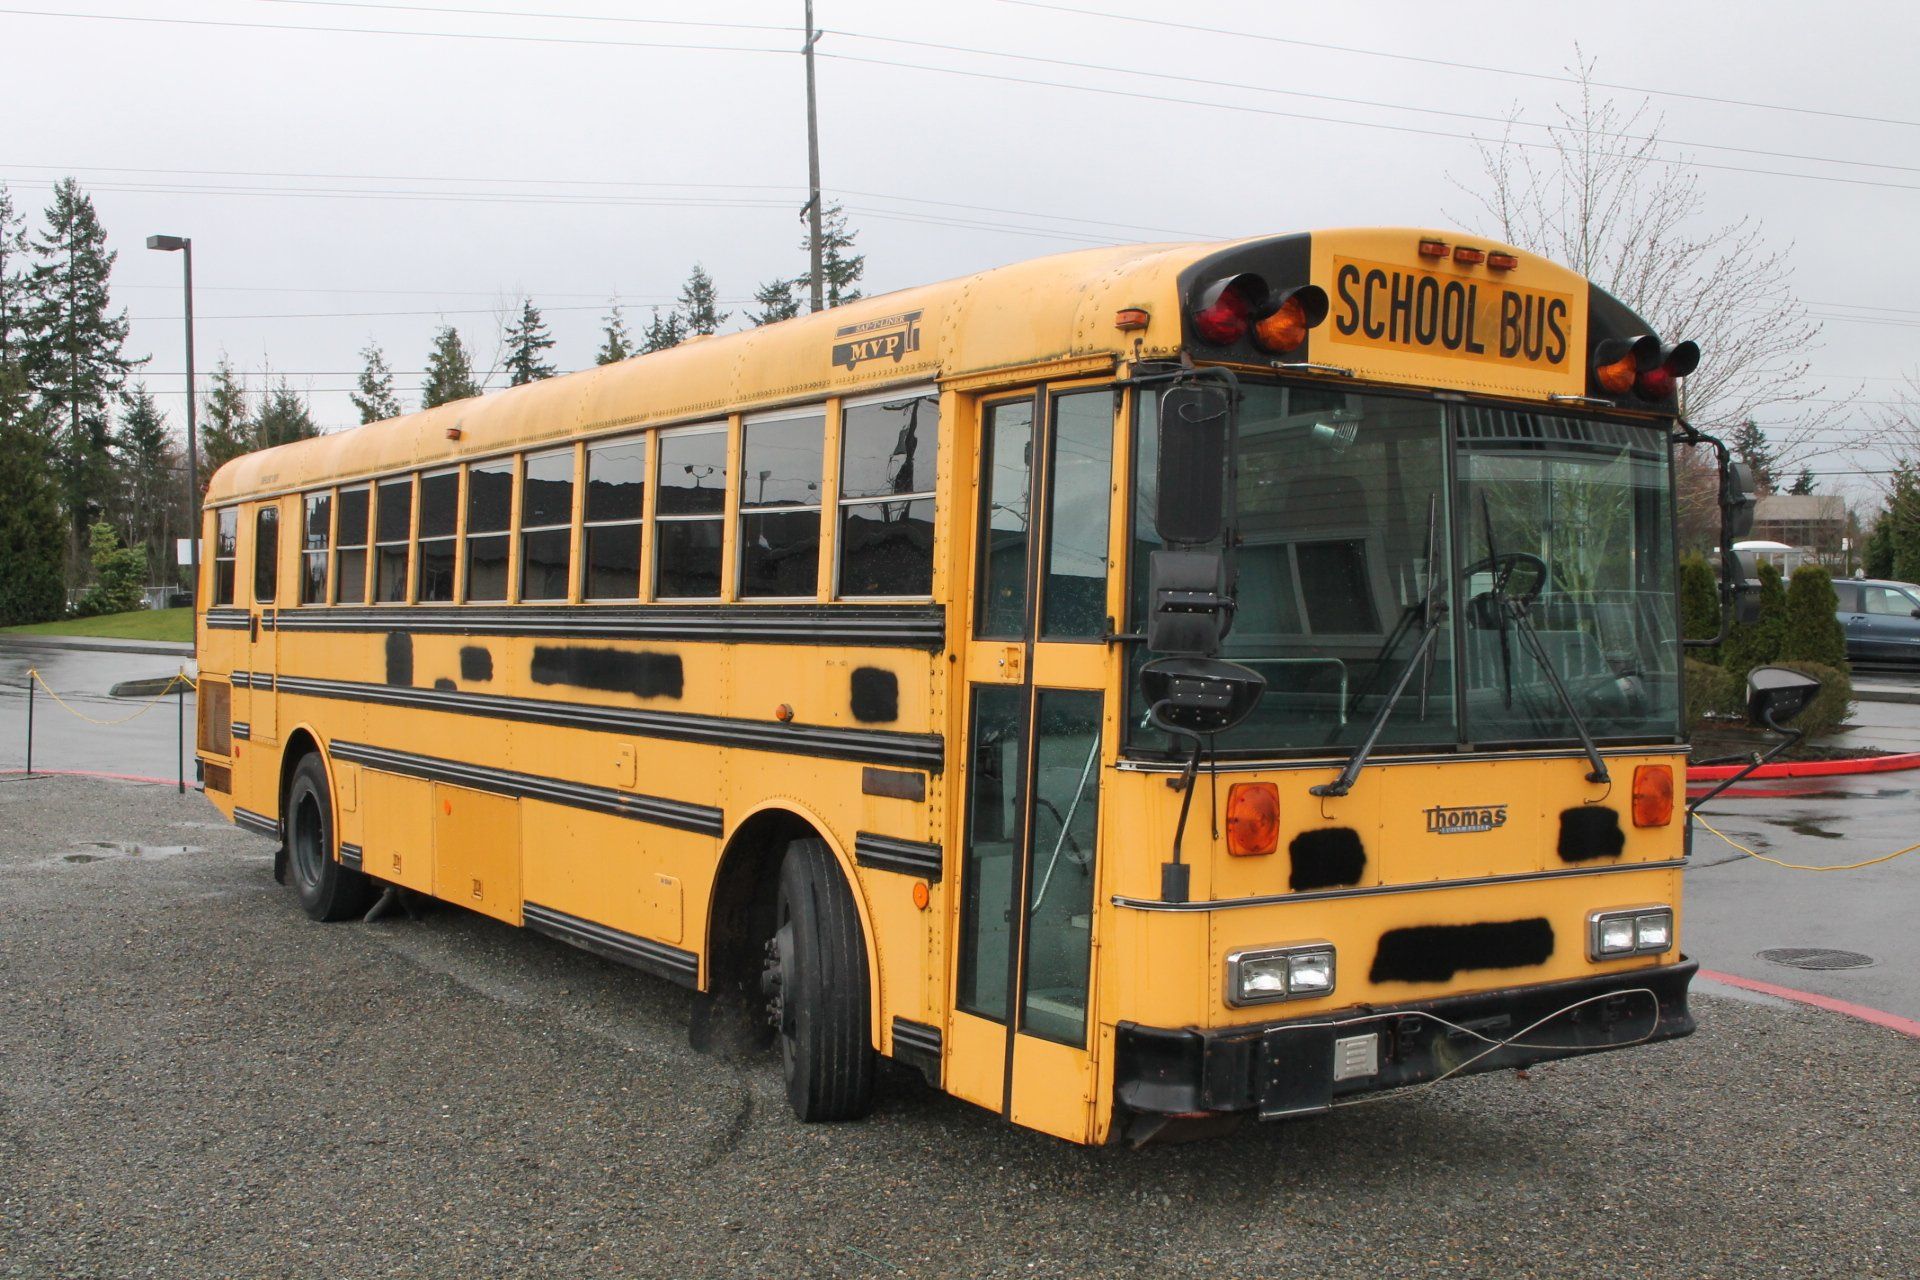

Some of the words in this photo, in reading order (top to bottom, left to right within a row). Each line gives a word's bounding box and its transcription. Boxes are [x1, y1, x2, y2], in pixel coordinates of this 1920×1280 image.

[1335, 264, 1485, 355] SCHOOL
[1499, 290, 1567, 365] BUS
[850, 335, 899, 361] MVP
[1422, 805, 1508, 832] Thomas
